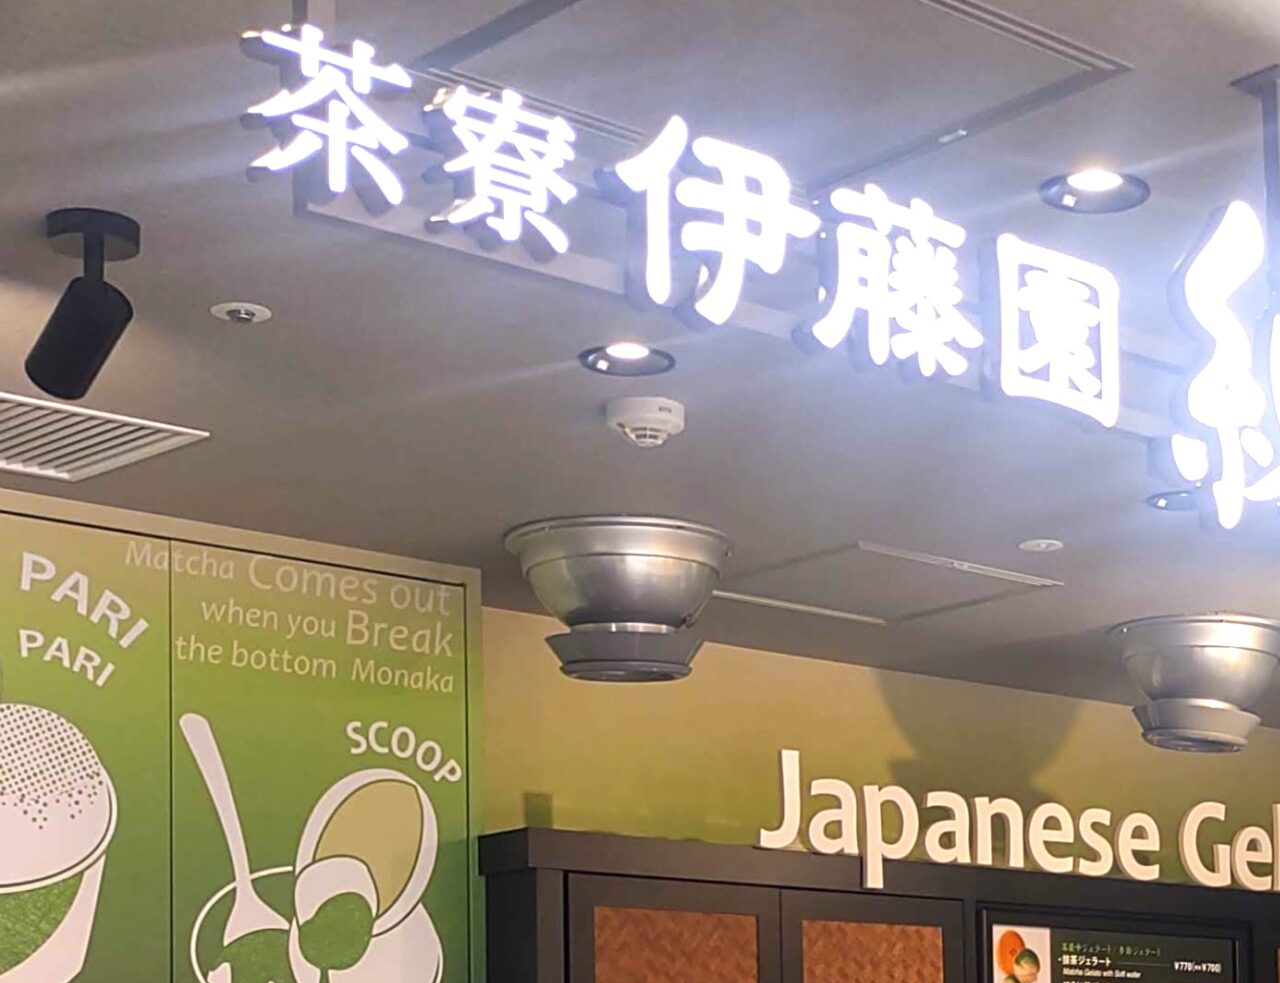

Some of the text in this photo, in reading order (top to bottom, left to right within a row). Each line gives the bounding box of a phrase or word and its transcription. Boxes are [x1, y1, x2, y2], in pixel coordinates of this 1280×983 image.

[20, 551, 149, 649] PARI
[125, 541, 451, 616] Matcha Comes out
[19, 628, 115, 687] PARI
[201, 598, 453, 658] when you Break
[174, 634, 454, 693] the bottom Monaka
[346, 721, 462, 782] SCOOP
[759, 748, 1161, 889] Japanese
